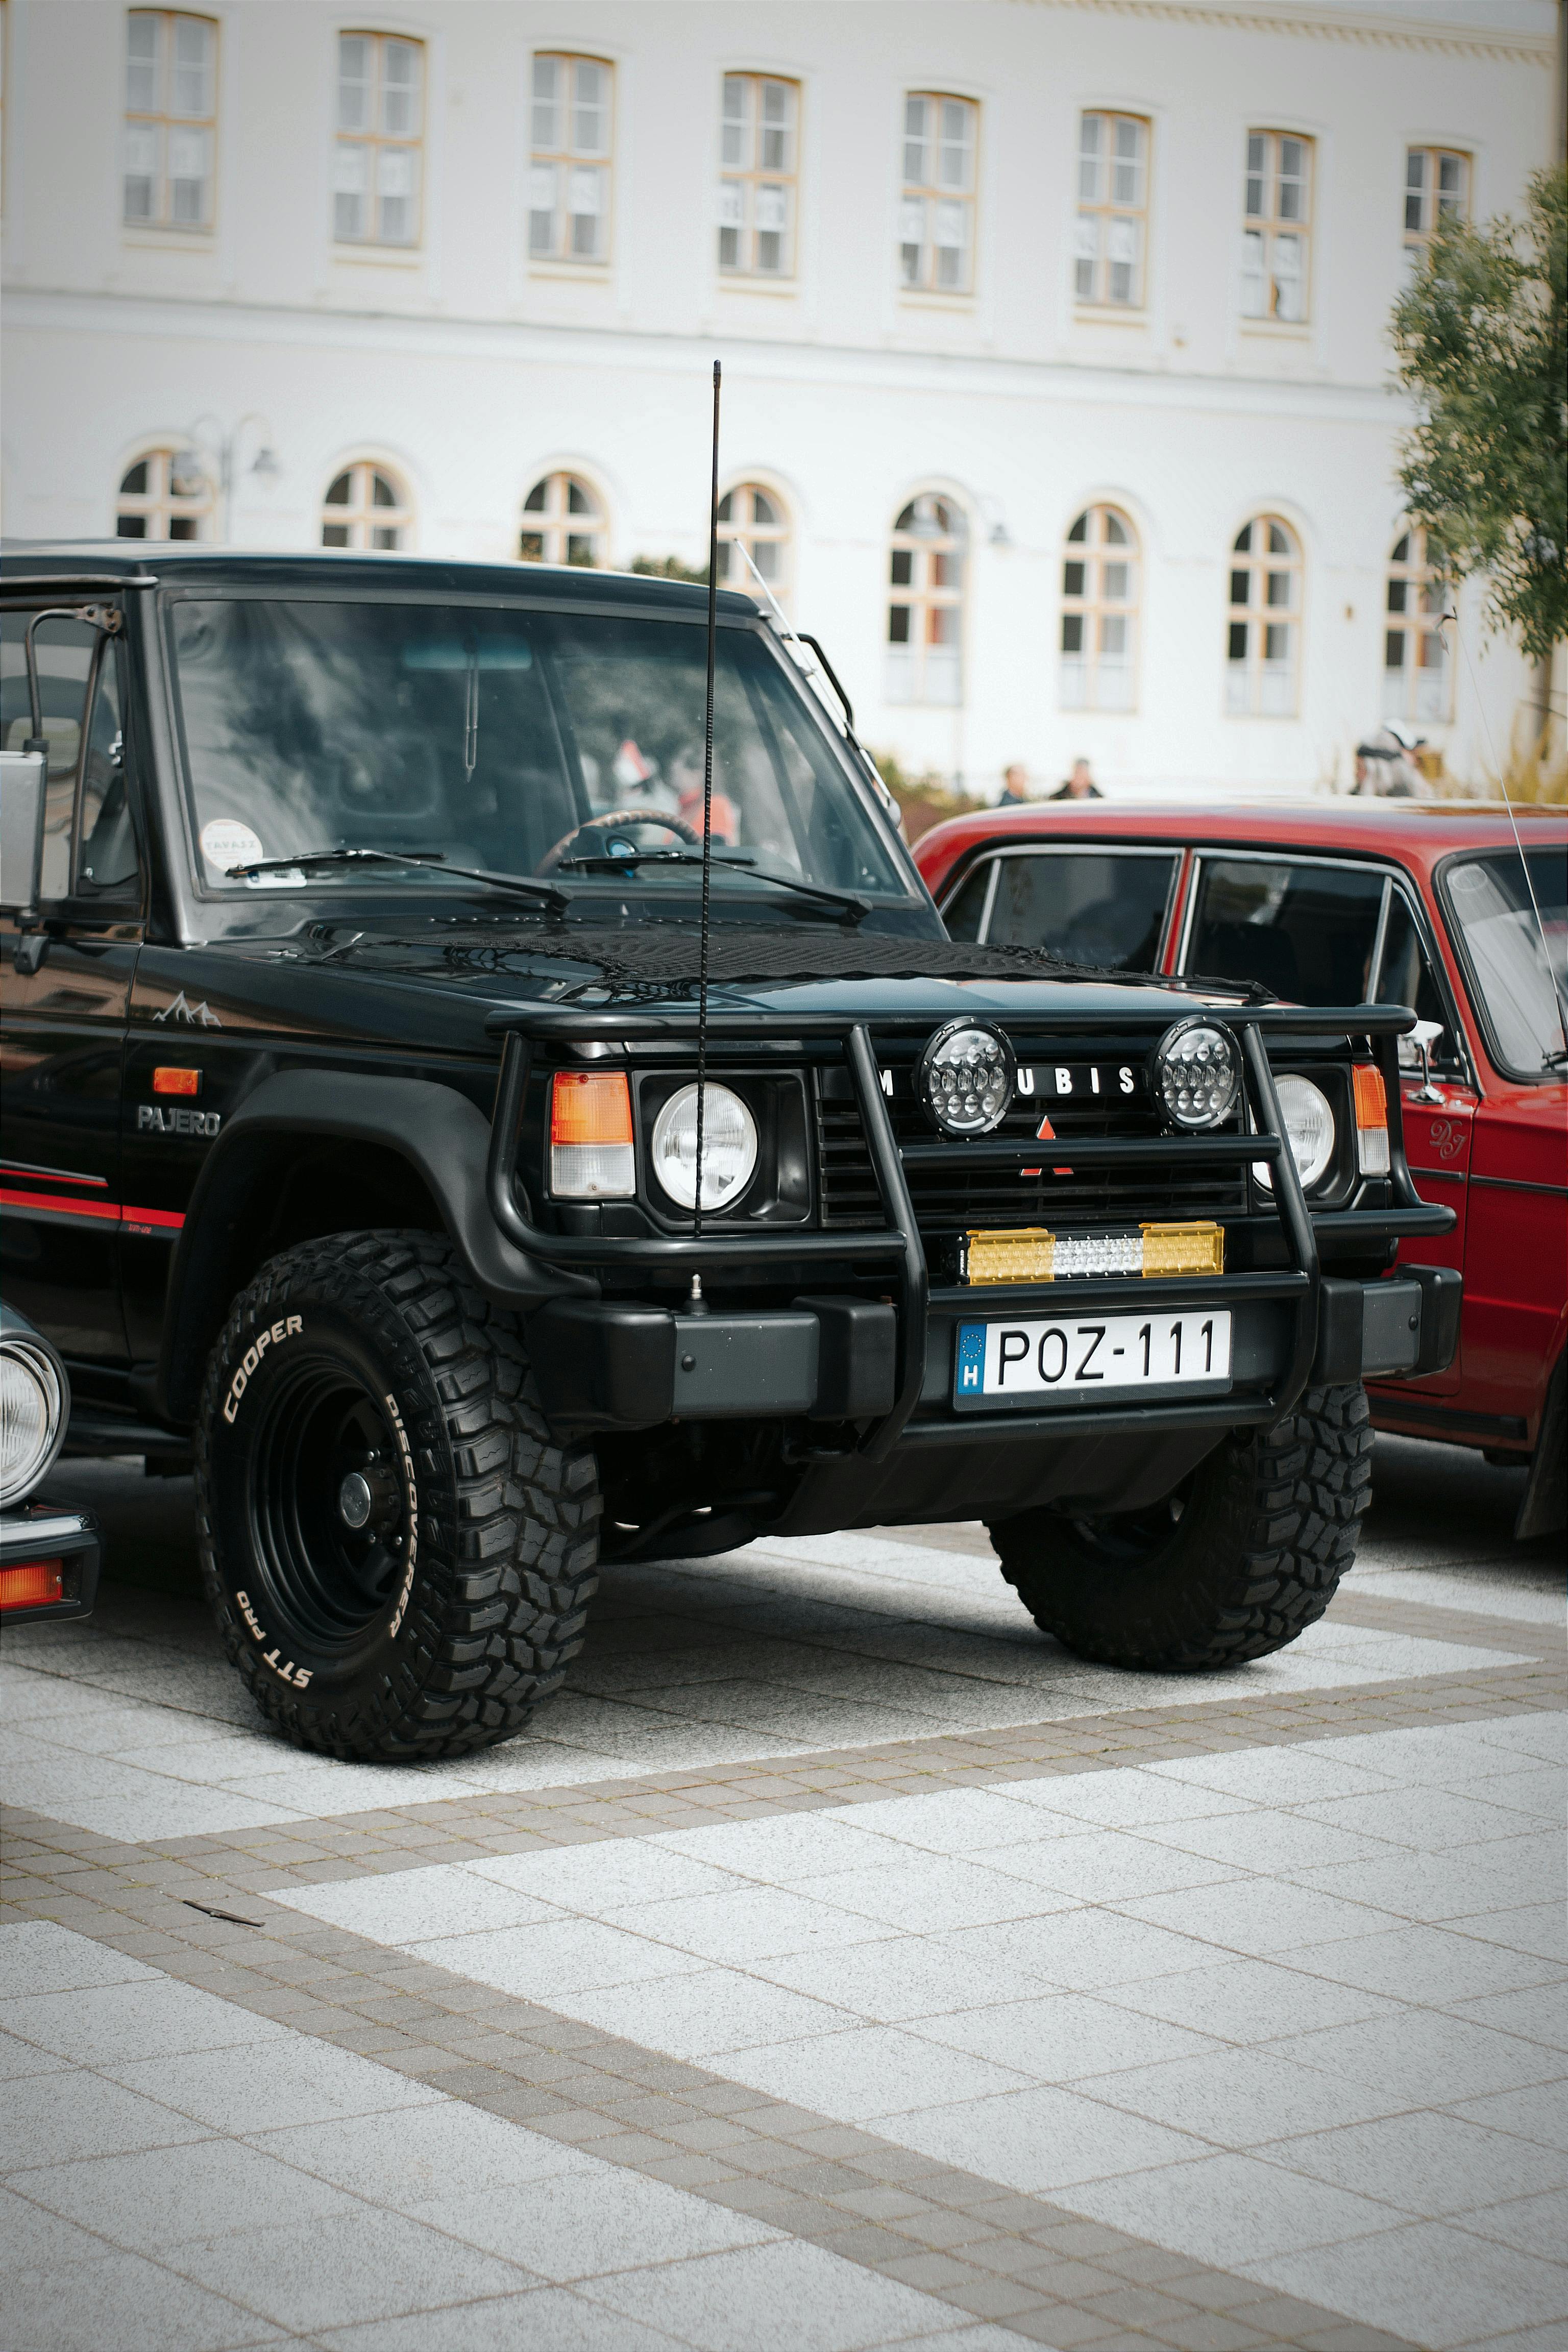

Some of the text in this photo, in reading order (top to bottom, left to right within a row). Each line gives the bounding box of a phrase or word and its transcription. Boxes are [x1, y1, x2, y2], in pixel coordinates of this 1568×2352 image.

[138, 1105, 220, 1136] PAJERO
[224, 1314, 304, 1423] COOPER
[963, 1319, 1213, 1387] H POZ-111
[385, 1393, 418, 1638] DISCOVERER
[236, 1590, 314, 1689] STT PRO
